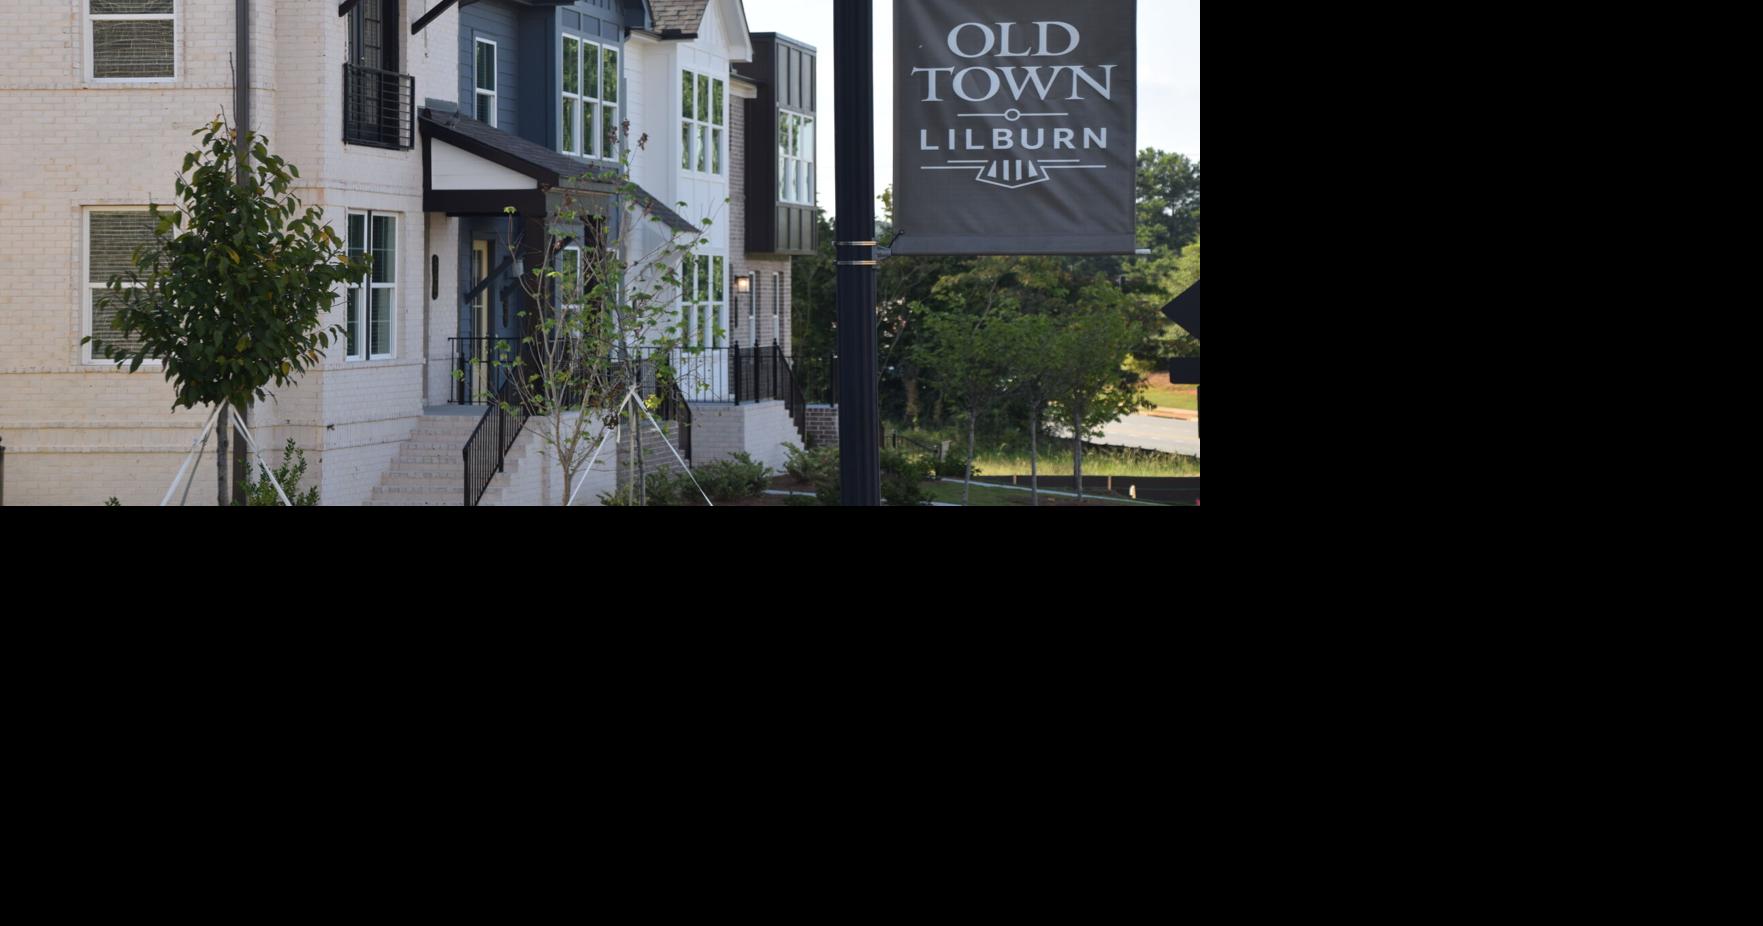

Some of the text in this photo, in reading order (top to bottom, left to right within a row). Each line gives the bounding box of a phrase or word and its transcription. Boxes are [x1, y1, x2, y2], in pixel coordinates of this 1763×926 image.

[947, 21, 1080, 58] OLD
[910, 64, 1118, 102] TOWN
[920, 127, 1107, 150] LILBURN
